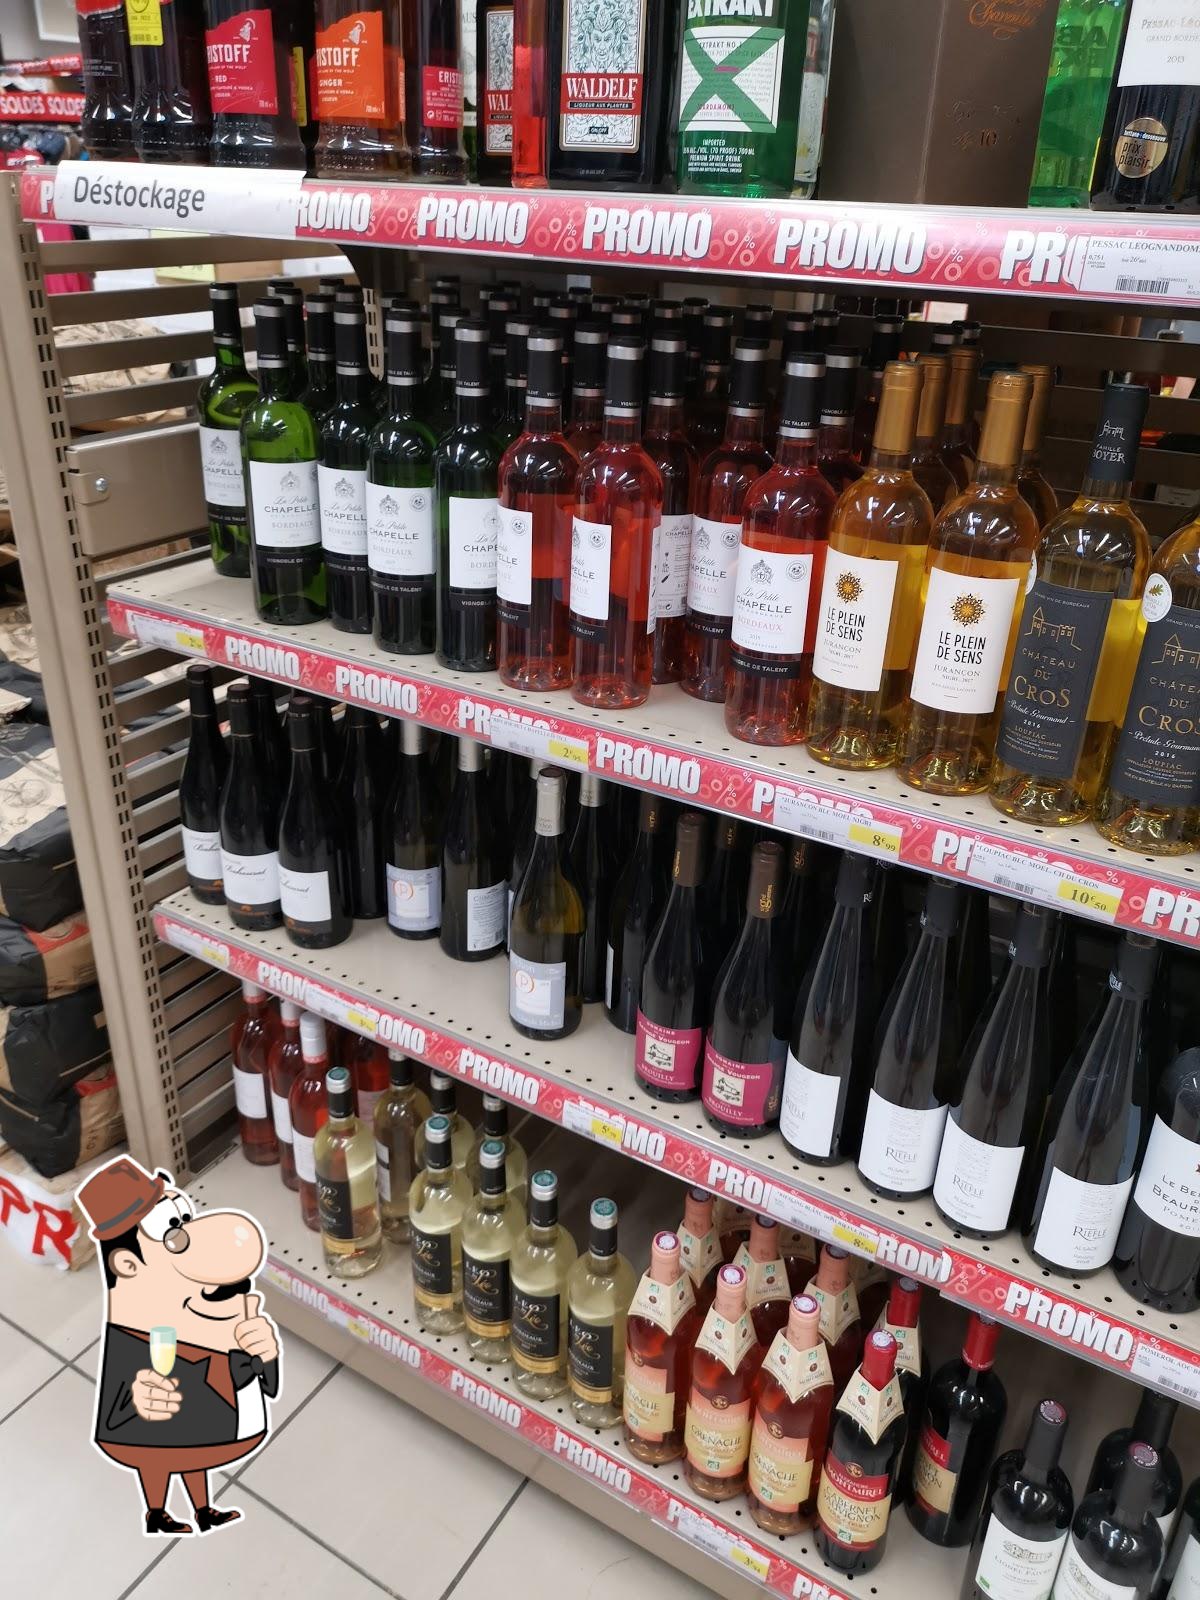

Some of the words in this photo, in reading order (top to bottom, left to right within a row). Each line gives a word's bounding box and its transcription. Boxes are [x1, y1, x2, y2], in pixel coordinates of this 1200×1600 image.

[566, 77, 638, 101] WALDELF
[0, 96, 45, 115] SOLDES
[1122, 140, 1142, 156] prix
[1118, 154, 1150, 169] plaisir
[74, 175, 206, 218] Déstockage
[416, 195, 530, 247] PROMO
[582, 206, 712, 260] PROMO
[774, 217, 928, 276] PROMO
[1092, 240, 1127, 249] PESSAC
[369, 526, 420, 540] CHAPELLE
[736, 594, 793, 615] CHAPELLE
[827, 605, 837, 621] LE
[838, 611, 867, 629] PLEIN
[825, 620, 837, 637] DE
[837, 624, 864, 643] SENS
[939, 630, 952, 646] LE
[954, 633, 988, 651] PLEIN
[937, 645, 951, 661] DE
[953, 648, 984, 666] SENS
[1034, 668, 1052, 681] DU
[1014, 675, 1072, 709] CROS
[1169, 698, 1190, 710] DU
[225, 635, 300, 681] PROMO
[336, 664, 419, 715] PROMO
[596, 737, 700, 795] PROMO
[1155, 750, 1176, 760] 2016
[458, 1048, 541, 1106] PROMO
[1162, 1174, 1176, 1188] LE
[1152, 1184, 1200, 1214] BEAUR
[1003, 1281, 1134, 1362] PROMO
[451, 1369, 522, 1429] PROMO
[554, 1430, 632, 1495] PROMO
